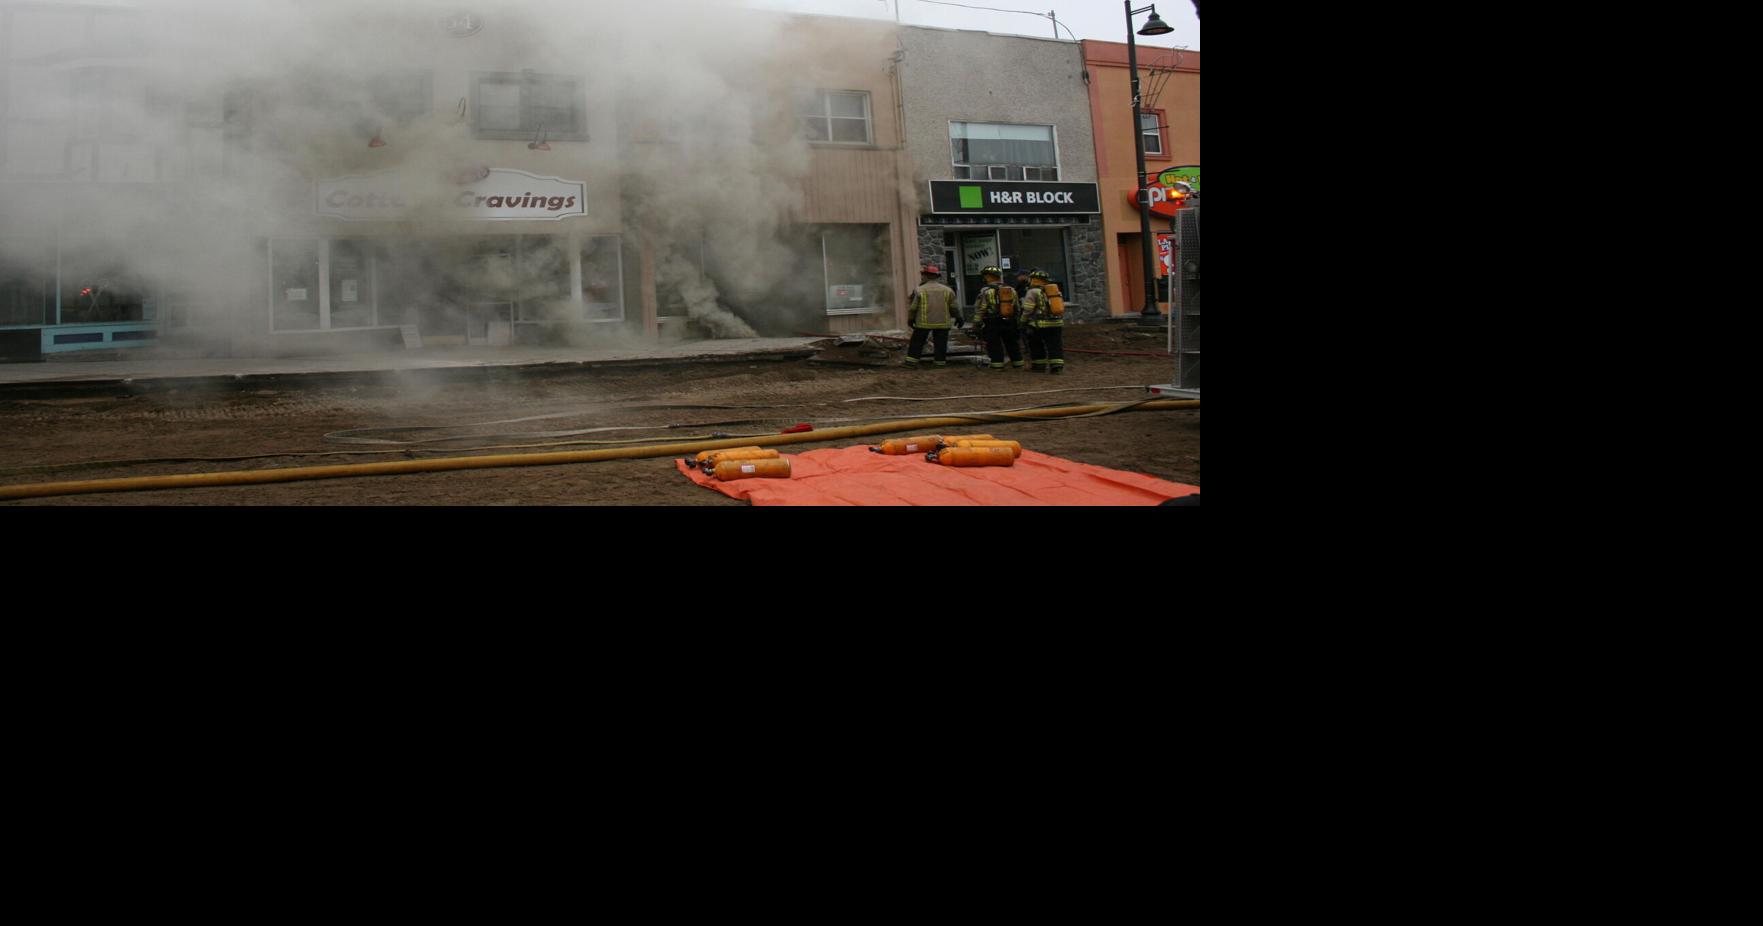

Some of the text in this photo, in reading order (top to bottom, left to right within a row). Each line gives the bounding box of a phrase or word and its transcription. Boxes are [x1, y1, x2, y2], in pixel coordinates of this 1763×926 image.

[453, 190, 576, 212] Cravings
[990, 191, 1075, 204] H&R BLOCK
